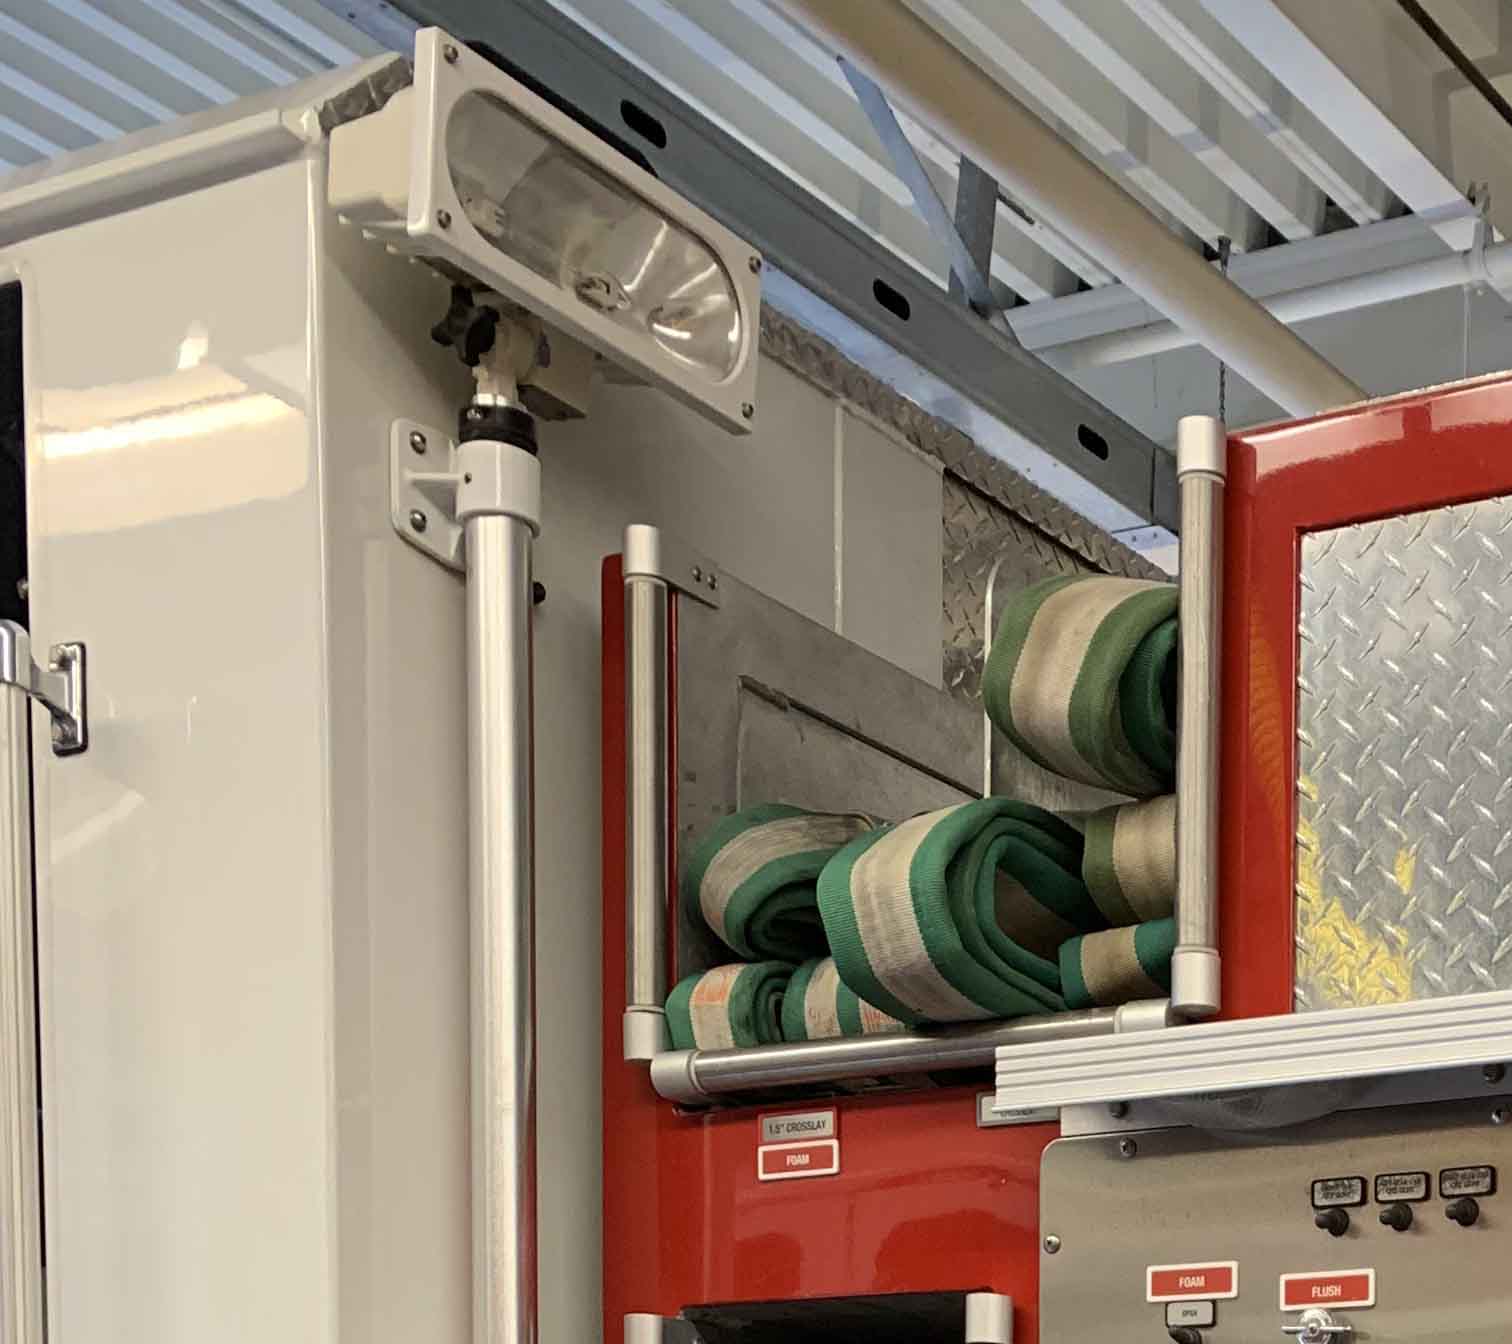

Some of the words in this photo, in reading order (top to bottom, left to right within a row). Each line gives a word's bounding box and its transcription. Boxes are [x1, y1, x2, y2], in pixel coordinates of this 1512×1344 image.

[786, 1120, 826, 1132] CROSSLAY
[786, 1153, 809, 1166] FOAM
[1179, 1276, 1205, 1288] FOAM
[1311, 1285, 1342, 1298] FLUSH
